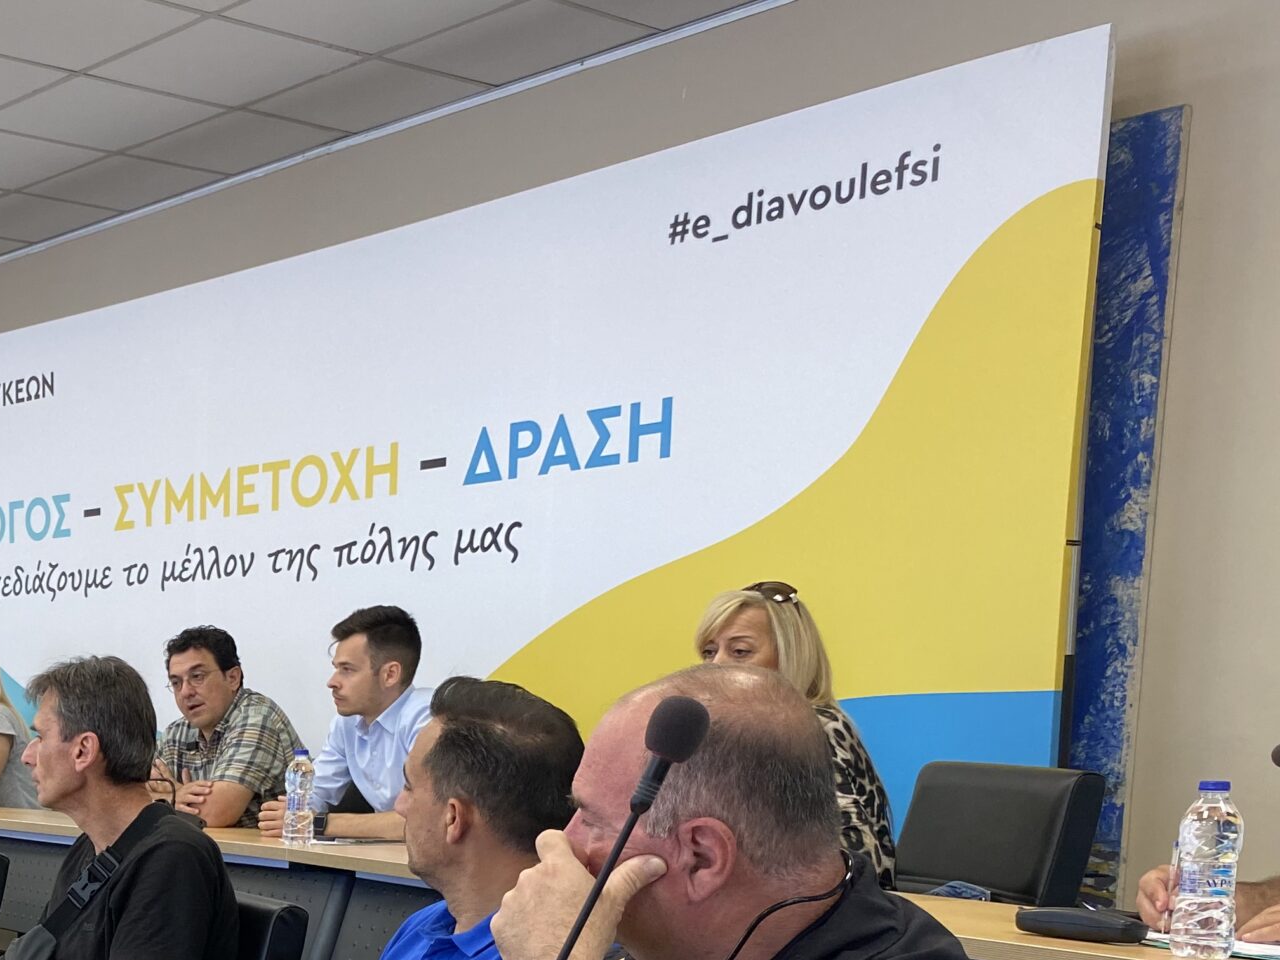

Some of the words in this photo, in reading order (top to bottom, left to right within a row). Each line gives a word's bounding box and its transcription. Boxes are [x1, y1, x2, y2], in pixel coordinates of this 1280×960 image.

[668, 143, 942, 246] #e_diavoulefsi
[113, 441, 400, 532] ΣΥΜΜΕΤΟΧΗ
[462, 396, 674, 487] ΔΡΑΣΗ
[122, 562, 150, 587] το
[160, 543, 255, 592] μέλλον
[266, 543, 321, 583] της
[332, 522, 439, 573] πόλης
[453, 520, 523, 567] μας
